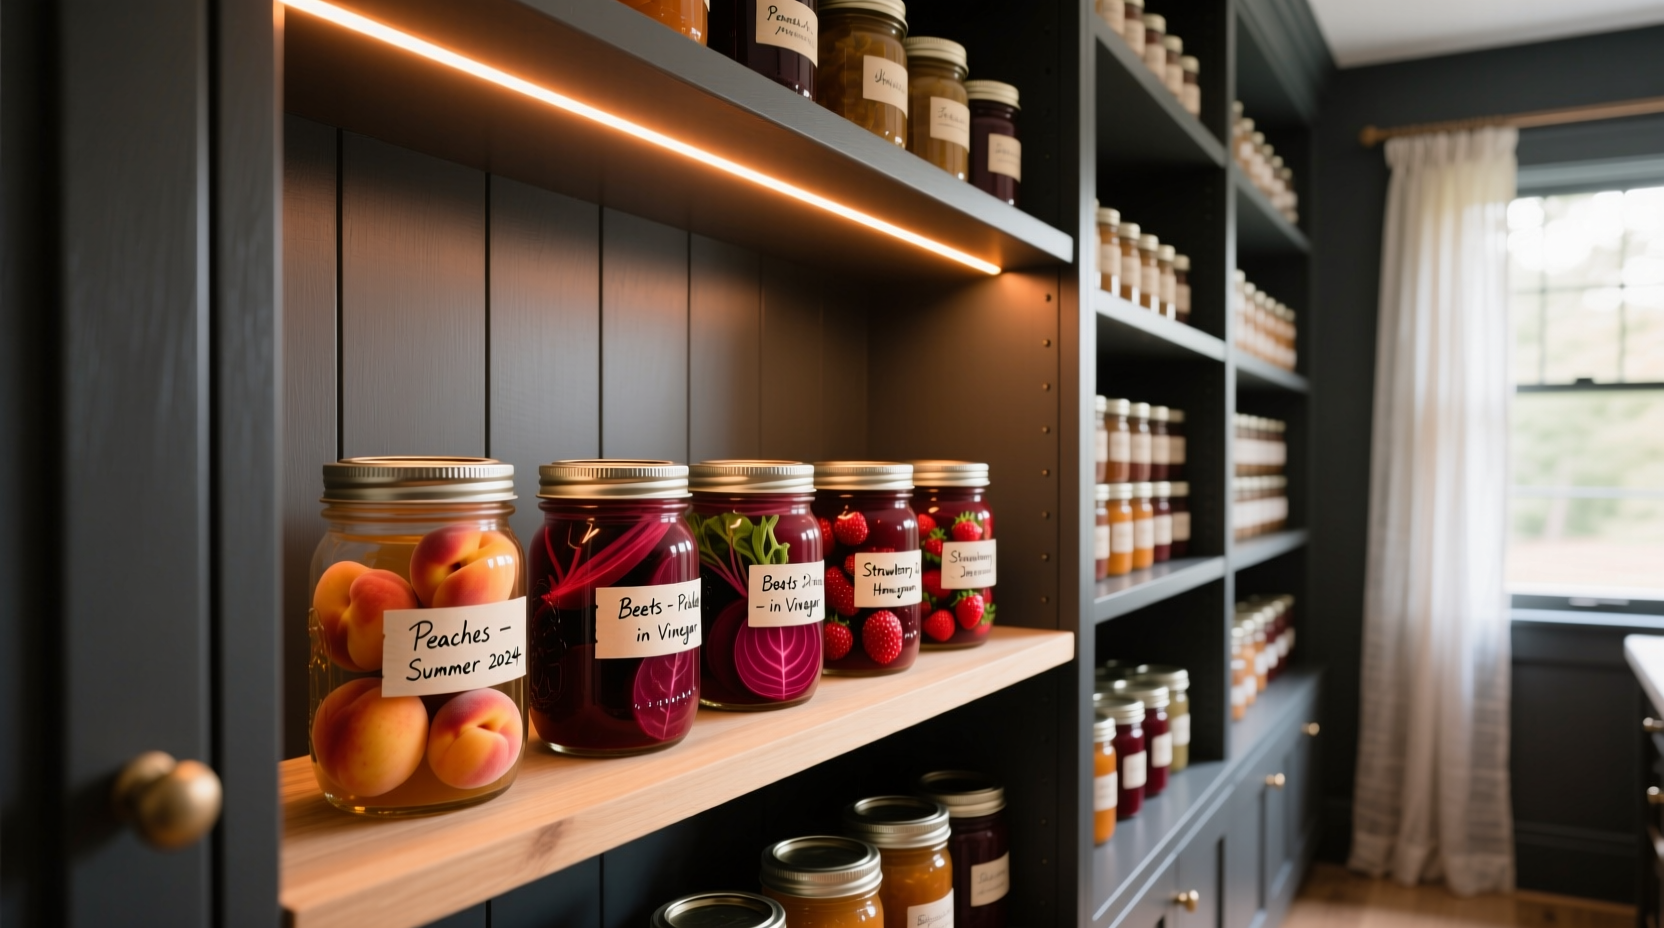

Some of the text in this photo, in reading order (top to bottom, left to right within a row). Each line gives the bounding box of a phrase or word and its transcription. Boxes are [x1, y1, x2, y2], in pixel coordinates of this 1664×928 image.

[618, 596, 663, 620] Beets
[769, 598, 781, 613] in
[408, 619, 491, 652] Peaches
[636, 622, 698, 646] in Vinegar
[405, 645, 522, 682] Summer 2024
